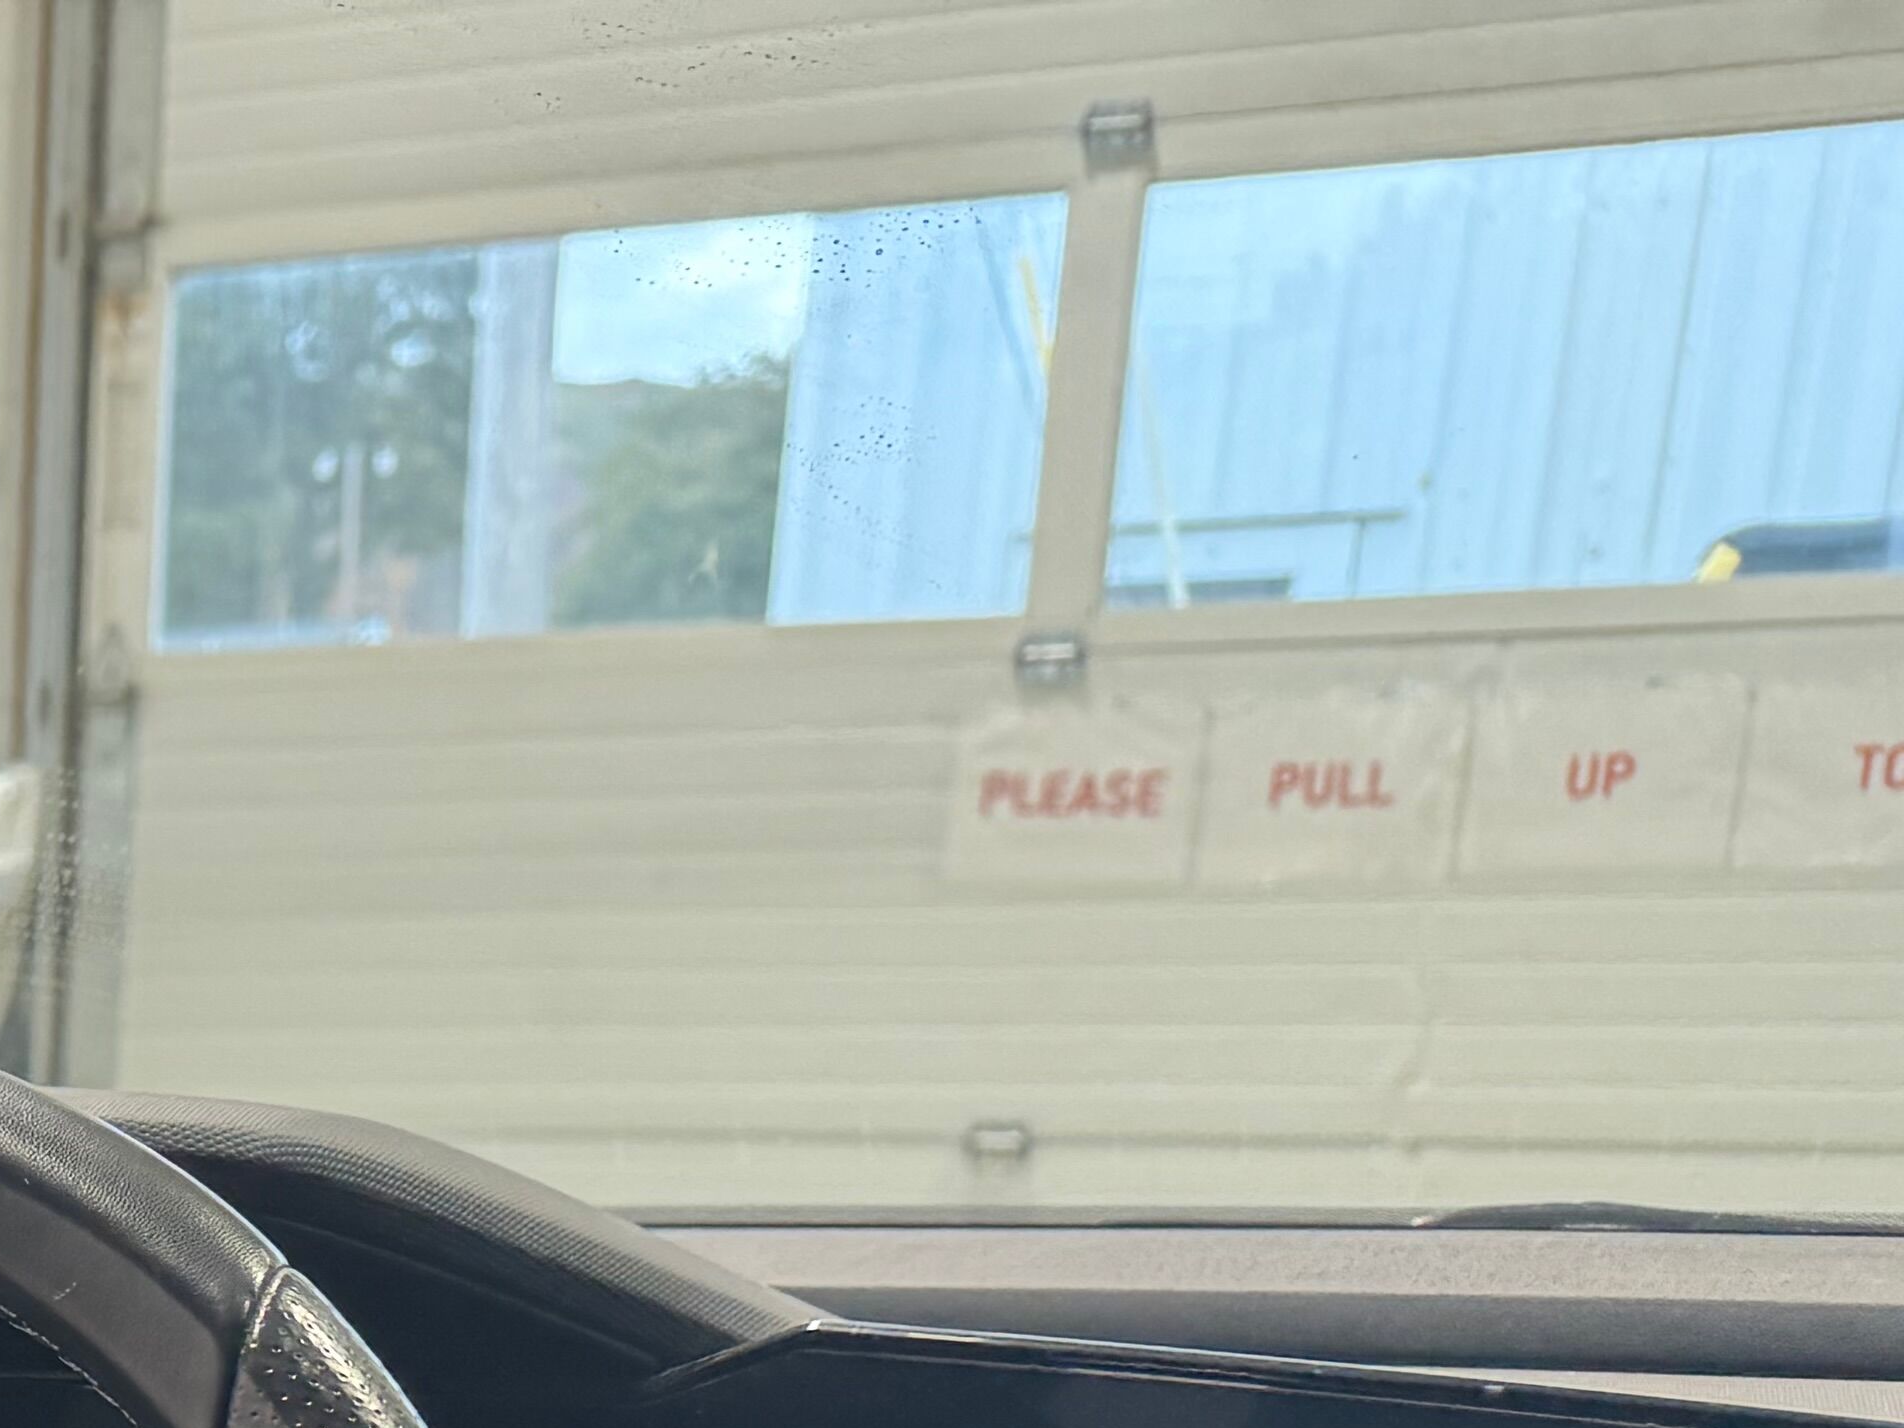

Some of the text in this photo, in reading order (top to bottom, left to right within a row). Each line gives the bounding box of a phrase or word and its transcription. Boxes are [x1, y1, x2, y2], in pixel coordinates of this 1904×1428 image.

[979, 766, 1168, 818] PLEASE
[1268, 761, 1394, 809] PULL
[1565, 752, 1637, 799] UP
